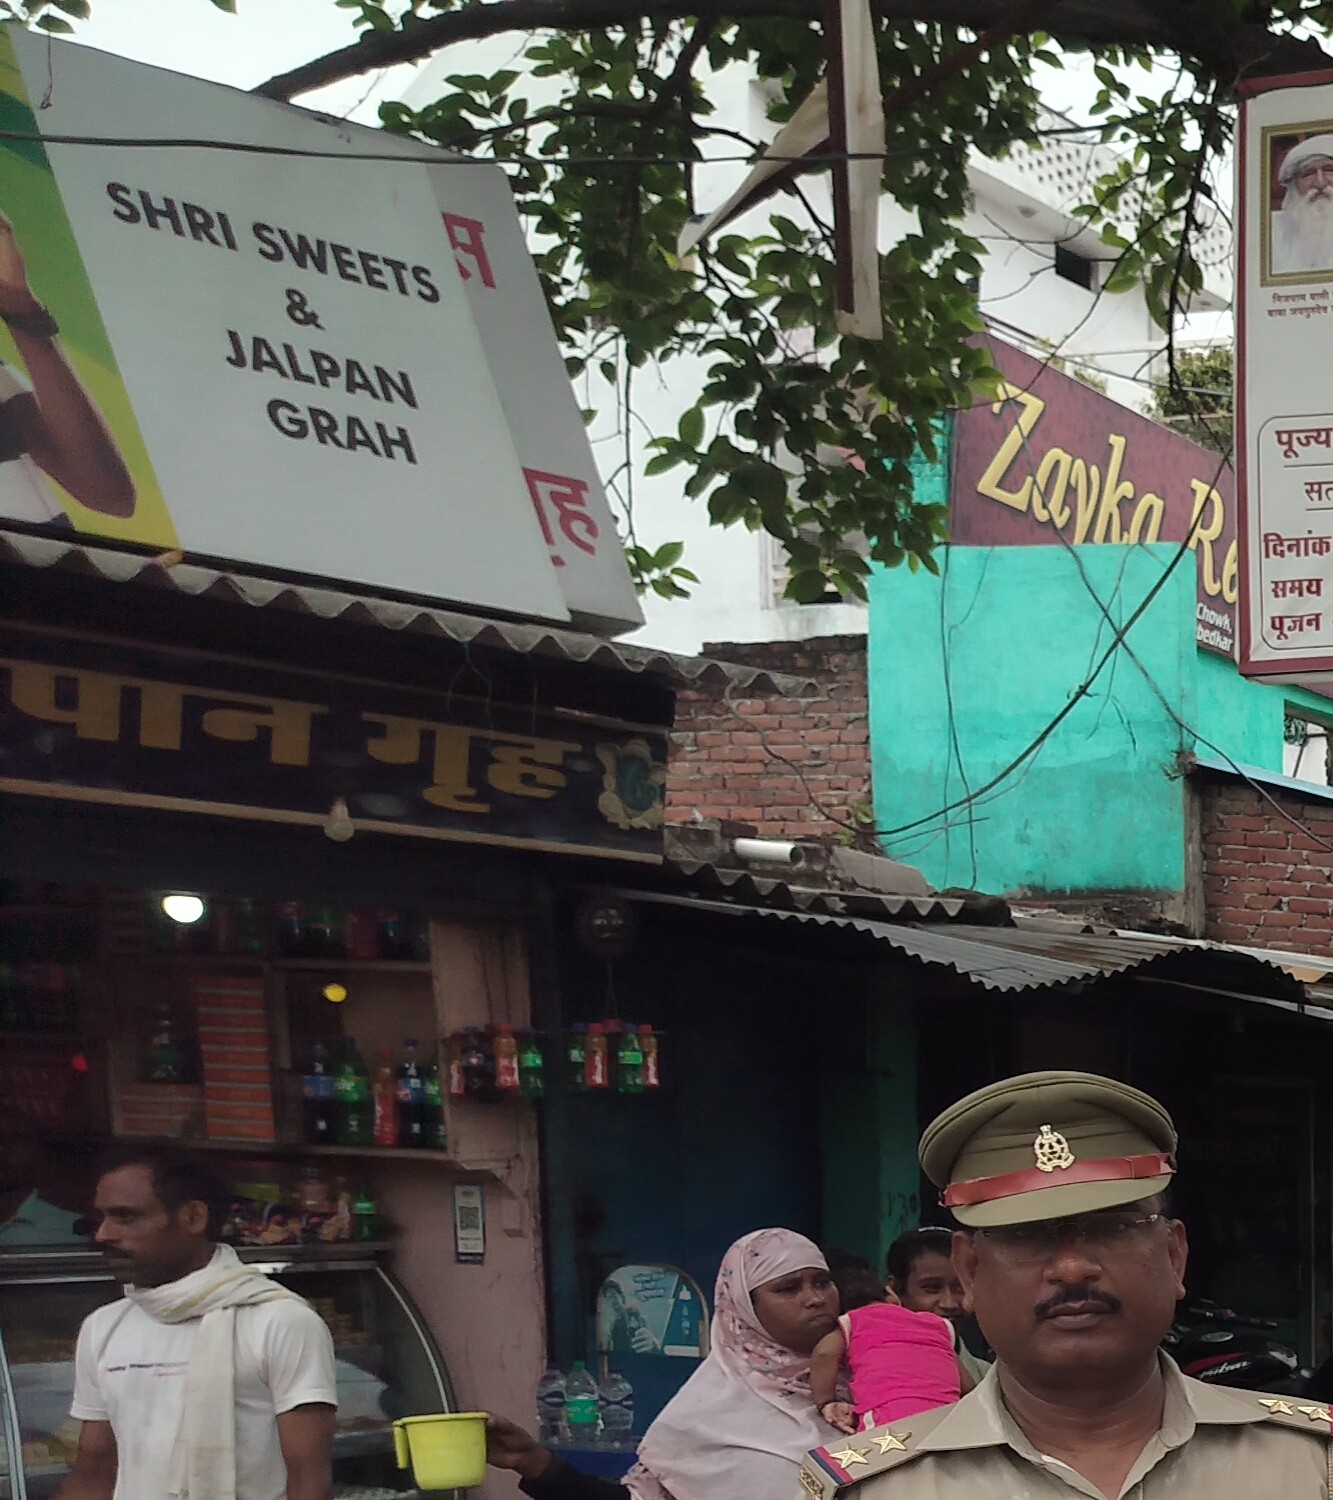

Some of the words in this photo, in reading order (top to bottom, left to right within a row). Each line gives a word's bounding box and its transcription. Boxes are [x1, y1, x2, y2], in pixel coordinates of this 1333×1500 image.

[104, 180, 239, 252] SHRI
[254, 220, 443, 306] SWEETS
[284, 288, 325, 332] &
[224, 329, 421, 410] JALPAN
[265, 398, 420, 467] GRAH
[976, 380, 1166, 546] Zayka
[1275, 426, 1332, 459] पूज्य
[1270, 577, 1323, 599] समय
[1270, 612, 1322, 642] पूजन
[8, 664, 331, 768] पान
[365, 712, 585, 815] गृह
